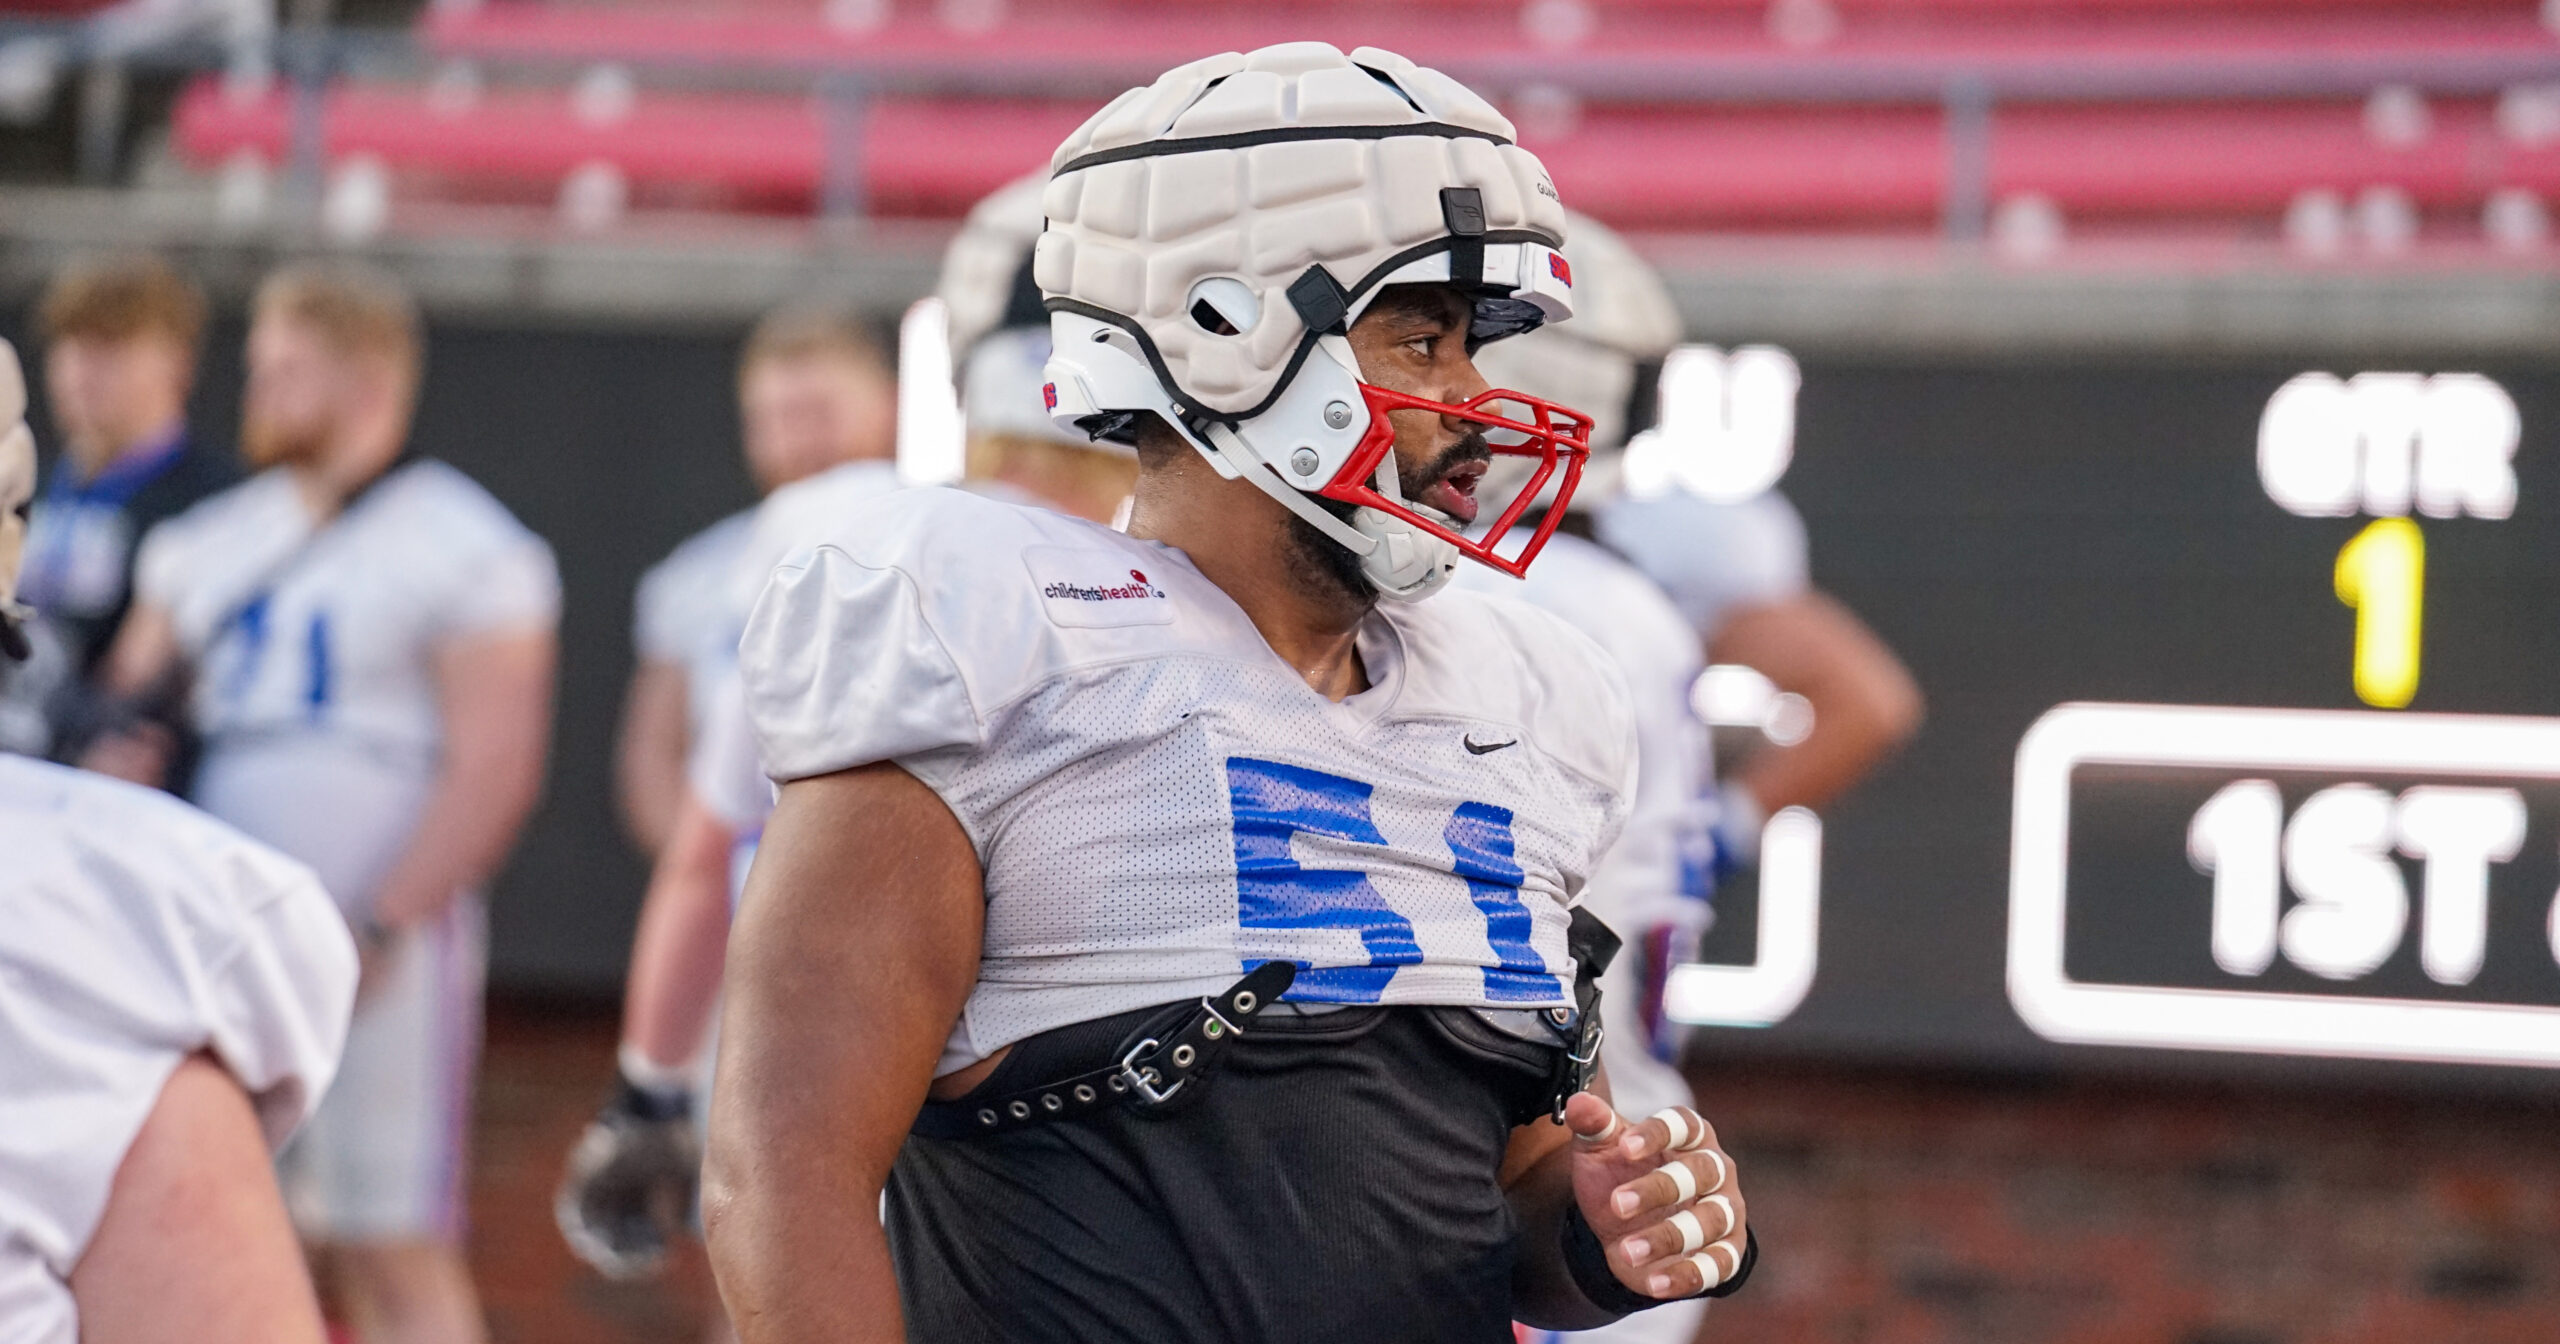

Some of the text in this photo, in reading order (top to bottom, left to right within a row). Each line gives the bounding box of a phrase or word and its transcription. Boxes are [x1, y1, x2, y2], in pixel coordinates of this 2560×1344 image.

[2333, 516, 2426, 709] 1
[1226, 756, 1565, 1004] 51
[2189, 779, 2527, 984] 1ST
